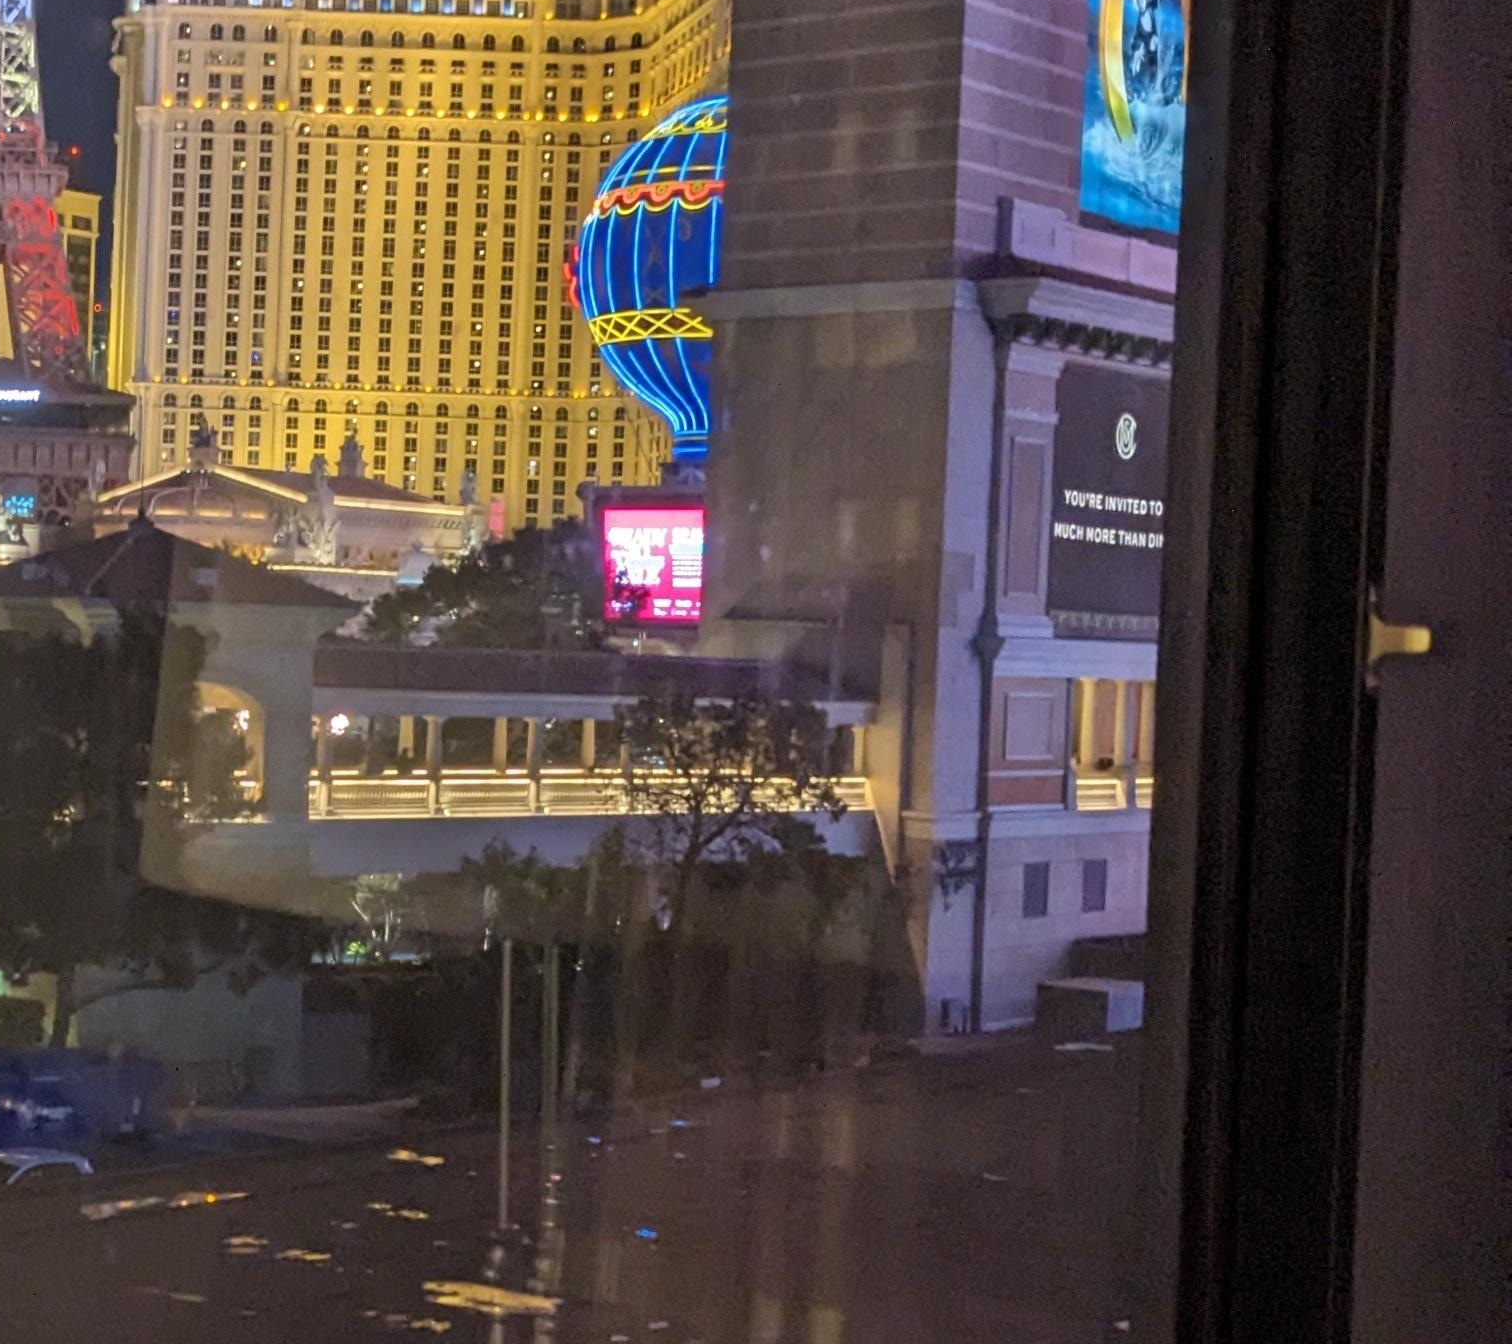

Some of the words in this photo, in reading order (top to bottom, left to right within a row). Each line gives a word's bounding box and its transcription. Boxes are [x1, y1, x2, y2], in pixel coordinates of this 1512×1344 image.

[1064, 489, 1104, 511] YOU'RE
[1104, 495, 1148, 516] INVITED
[1149, 500, 1164, 517] TO
[1053, 521, 1085, 541] MUCH
[1085, 526, 1117, 545] MORE
[1118, 529, 1147, 549] THAN
